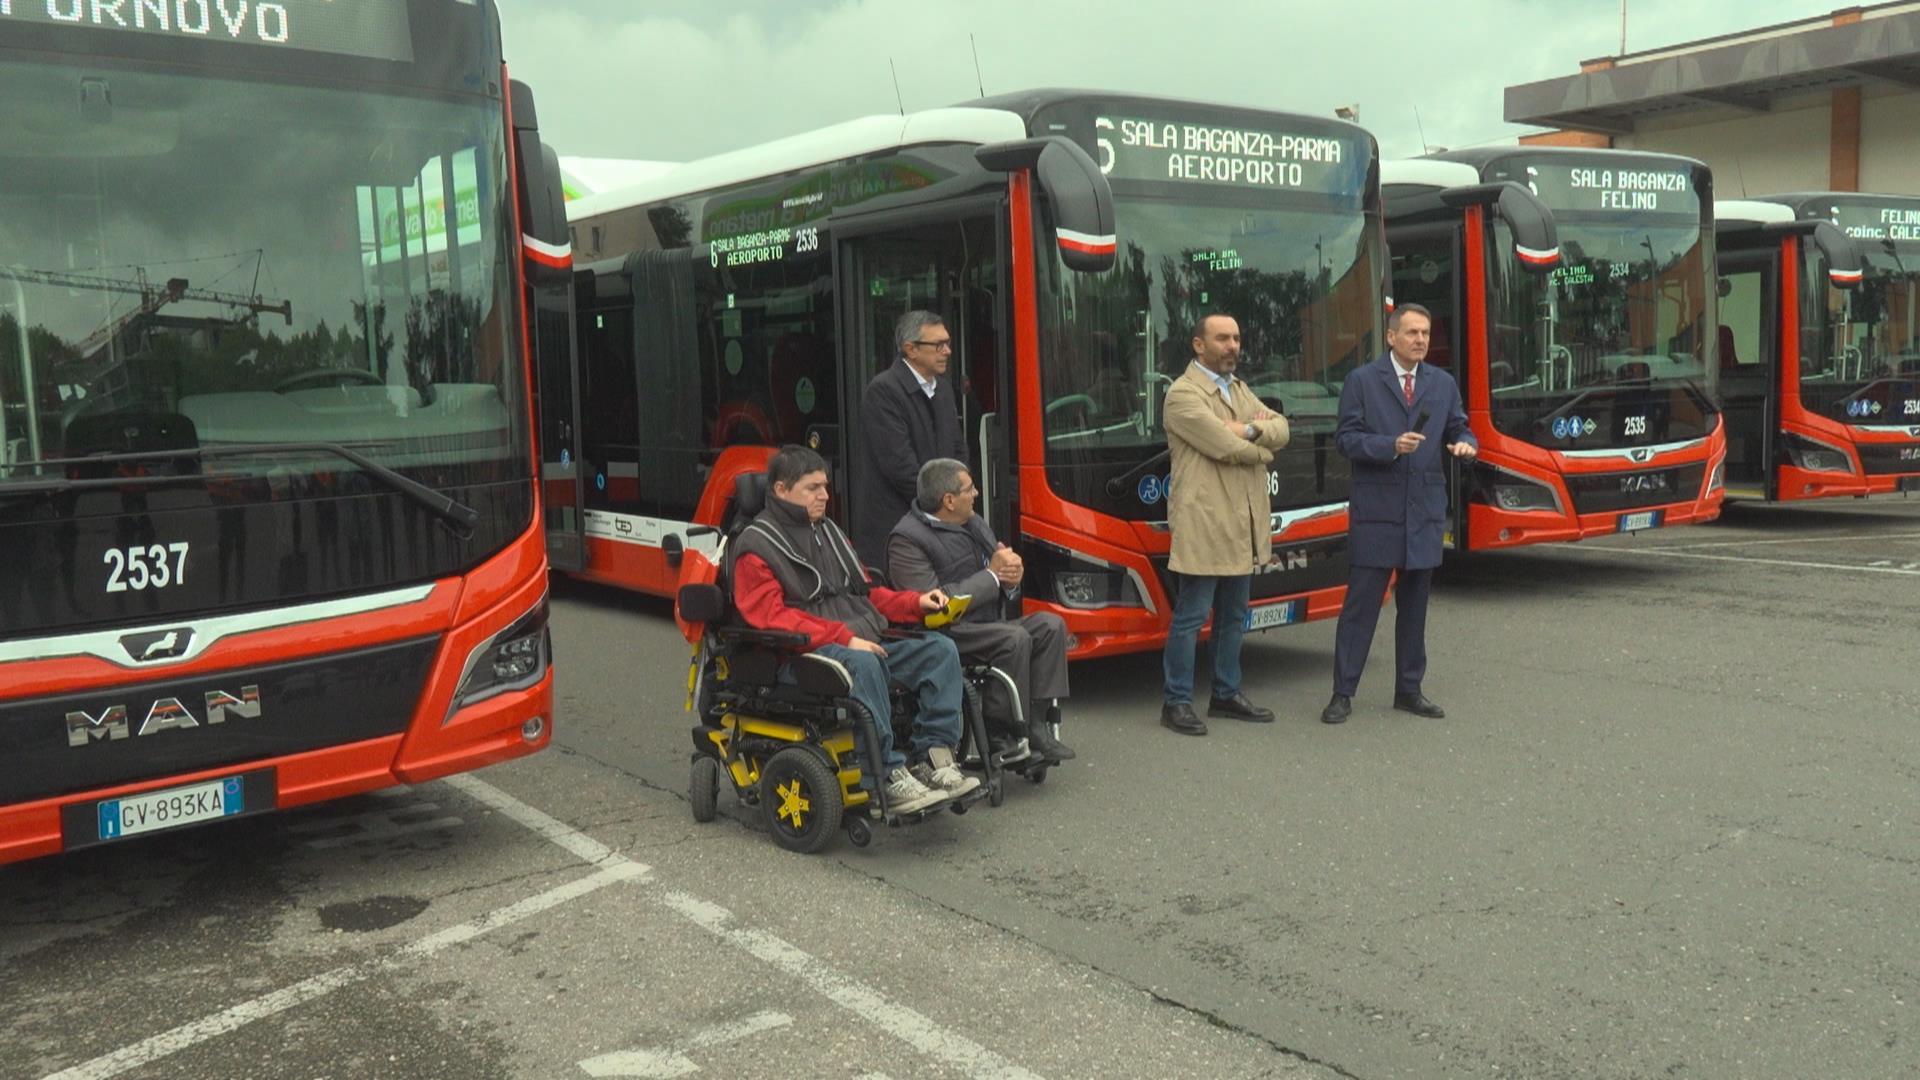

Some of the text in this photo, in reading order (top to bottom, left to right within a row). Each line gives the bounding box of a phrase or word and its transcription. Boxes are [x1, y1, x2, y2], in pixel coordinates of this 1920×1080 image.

[1121, 119, 1340, 163] SALA BAGANZA-PARMA
[1168, 153, 1302, 187] AEROPORTO
[1571, 169, 1686, 191] SALA BAGANZA
[1601, 191, 1657, 209] FELINO
[1881, 208, 1920, 225] FELIN
[717, 238, 734, 252] SALA
[796, 227, 818, 253] 2536
[710, 240, 718, 268] 6
[727, 245, 783, 266] AEROPORTO
[1210, 257, 1243, 271] FELIN
[1609, 262, 1630, 277] 2534
[1624, 416, 1646, 435] 2535
[104, 542, 189, 592] 2537
[66, 685, 260, 746] MAN
